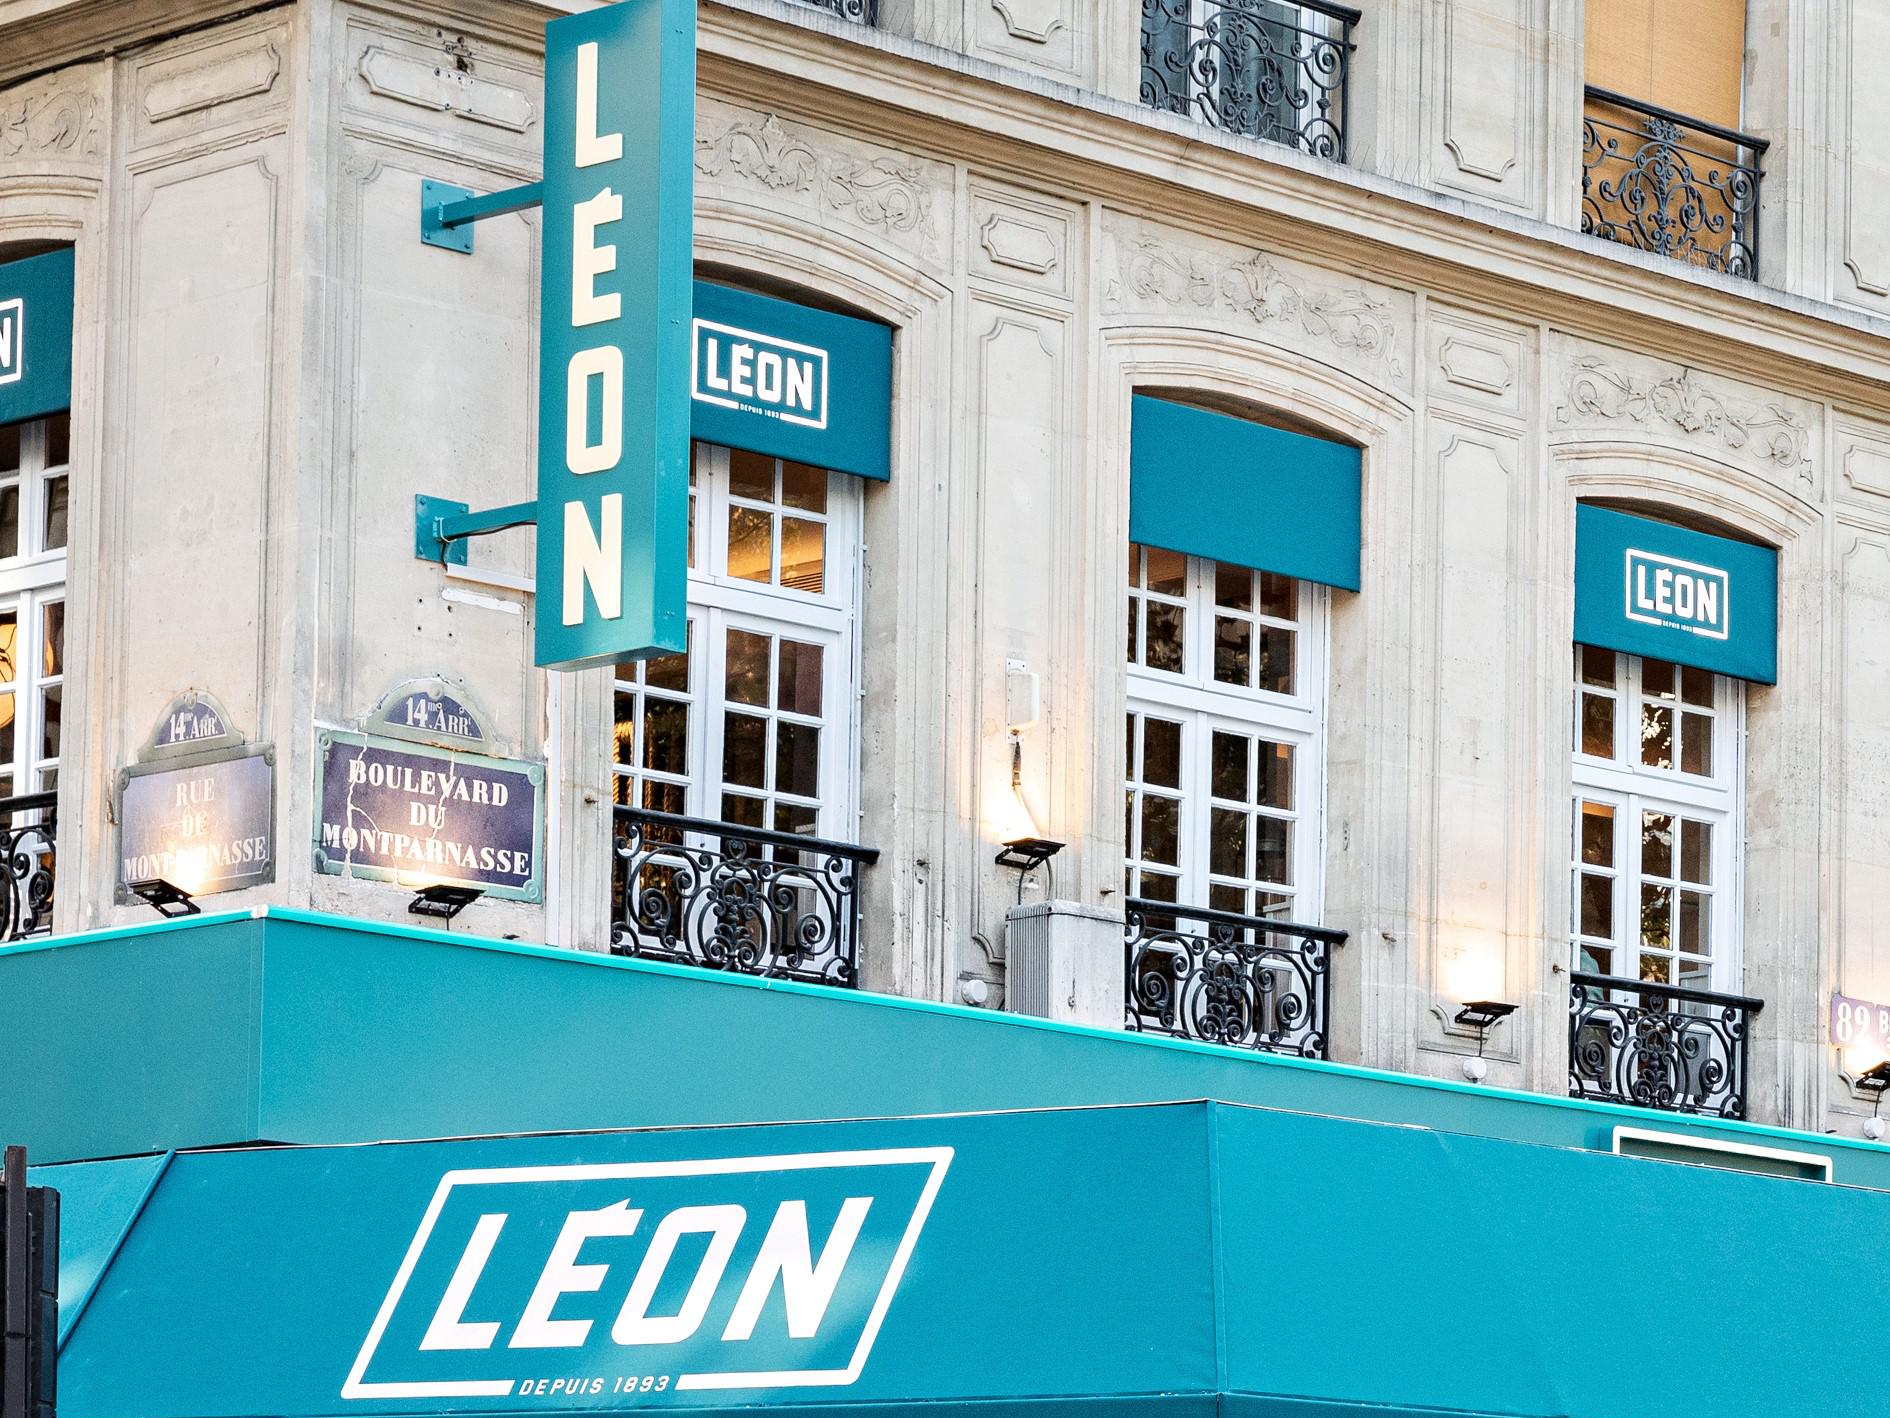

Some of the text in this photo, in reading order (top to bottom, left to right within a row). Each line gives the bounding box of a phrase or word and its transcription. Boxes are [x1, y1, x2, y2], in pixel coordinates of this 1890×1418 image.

[562, 42, 625, 625] LÉON
[706, 337, 813, 411] LÉON
[1637, 564, 1717, 625] LÉON
[175, 779, 215, 807] RUE
[348, 759, 510, 807] BOULEVARD
[409, 801, 446, 830] DU
[123, 836, 266, 882] MONTNASSE
[322, 822, 531, 877] MONTPARNASSE
[418, 1197, 874, 1351] LÉON
[519, 1374, 671, 1397] DEPUIS 1893
